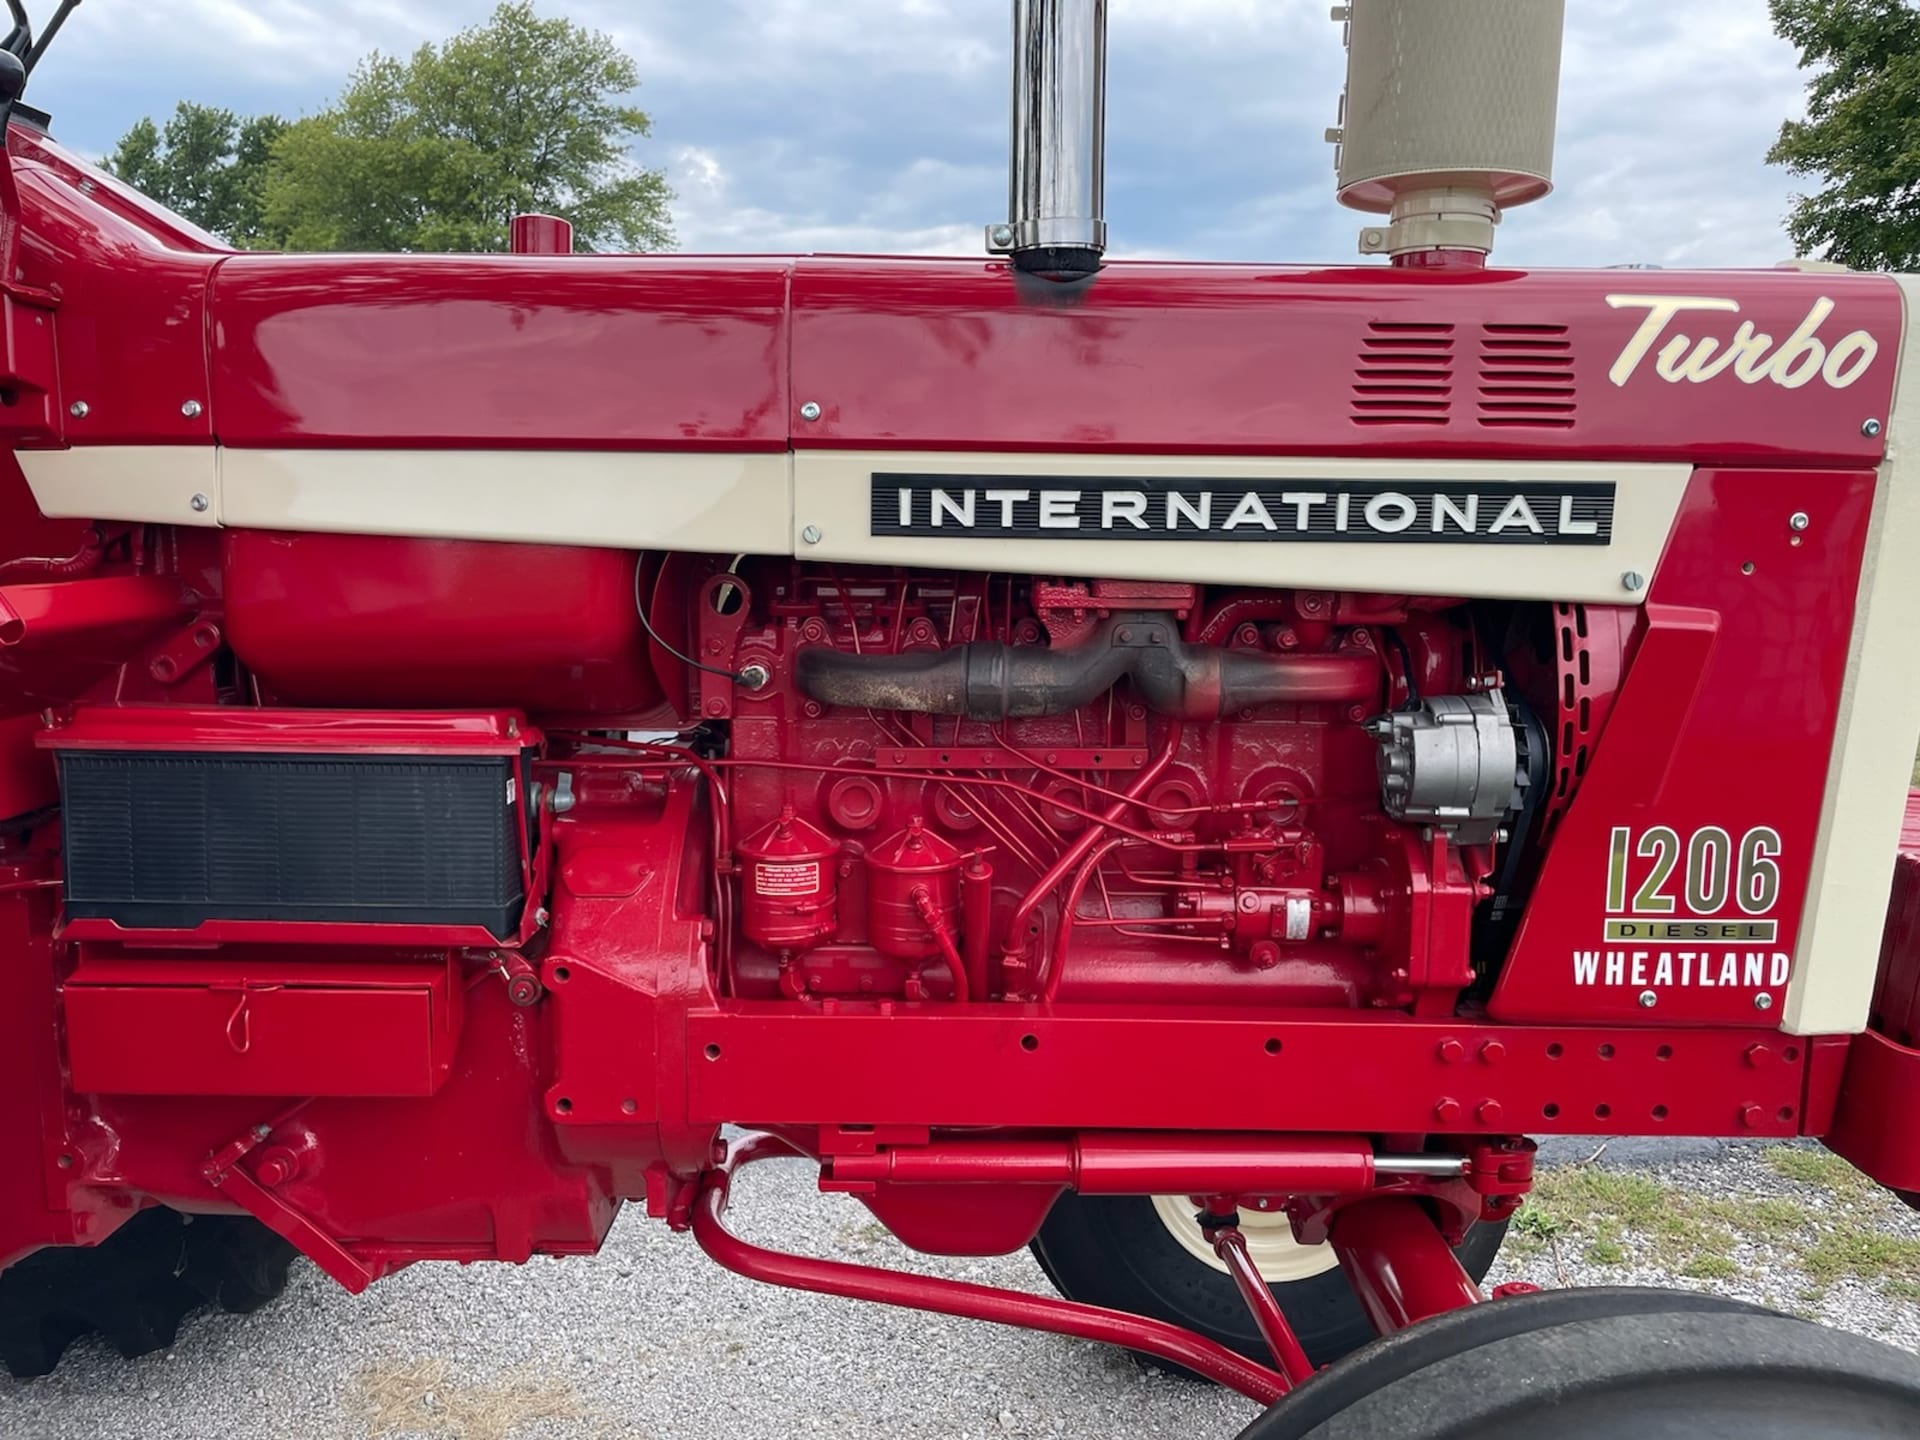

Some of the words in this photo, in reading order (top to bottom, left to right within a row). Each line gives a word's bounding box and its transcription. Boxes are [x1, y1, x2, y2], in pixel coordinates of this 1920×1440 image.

[1605, 294, 1878, 388] Turbo
[898, 488, 1598, 534] INTERNATIONAL
[1605, 825, 1782, 915] 1206
[1619, 924, 1762, 937] DIESEL
[1573, 951, 1790, 986] WHEATLAND
